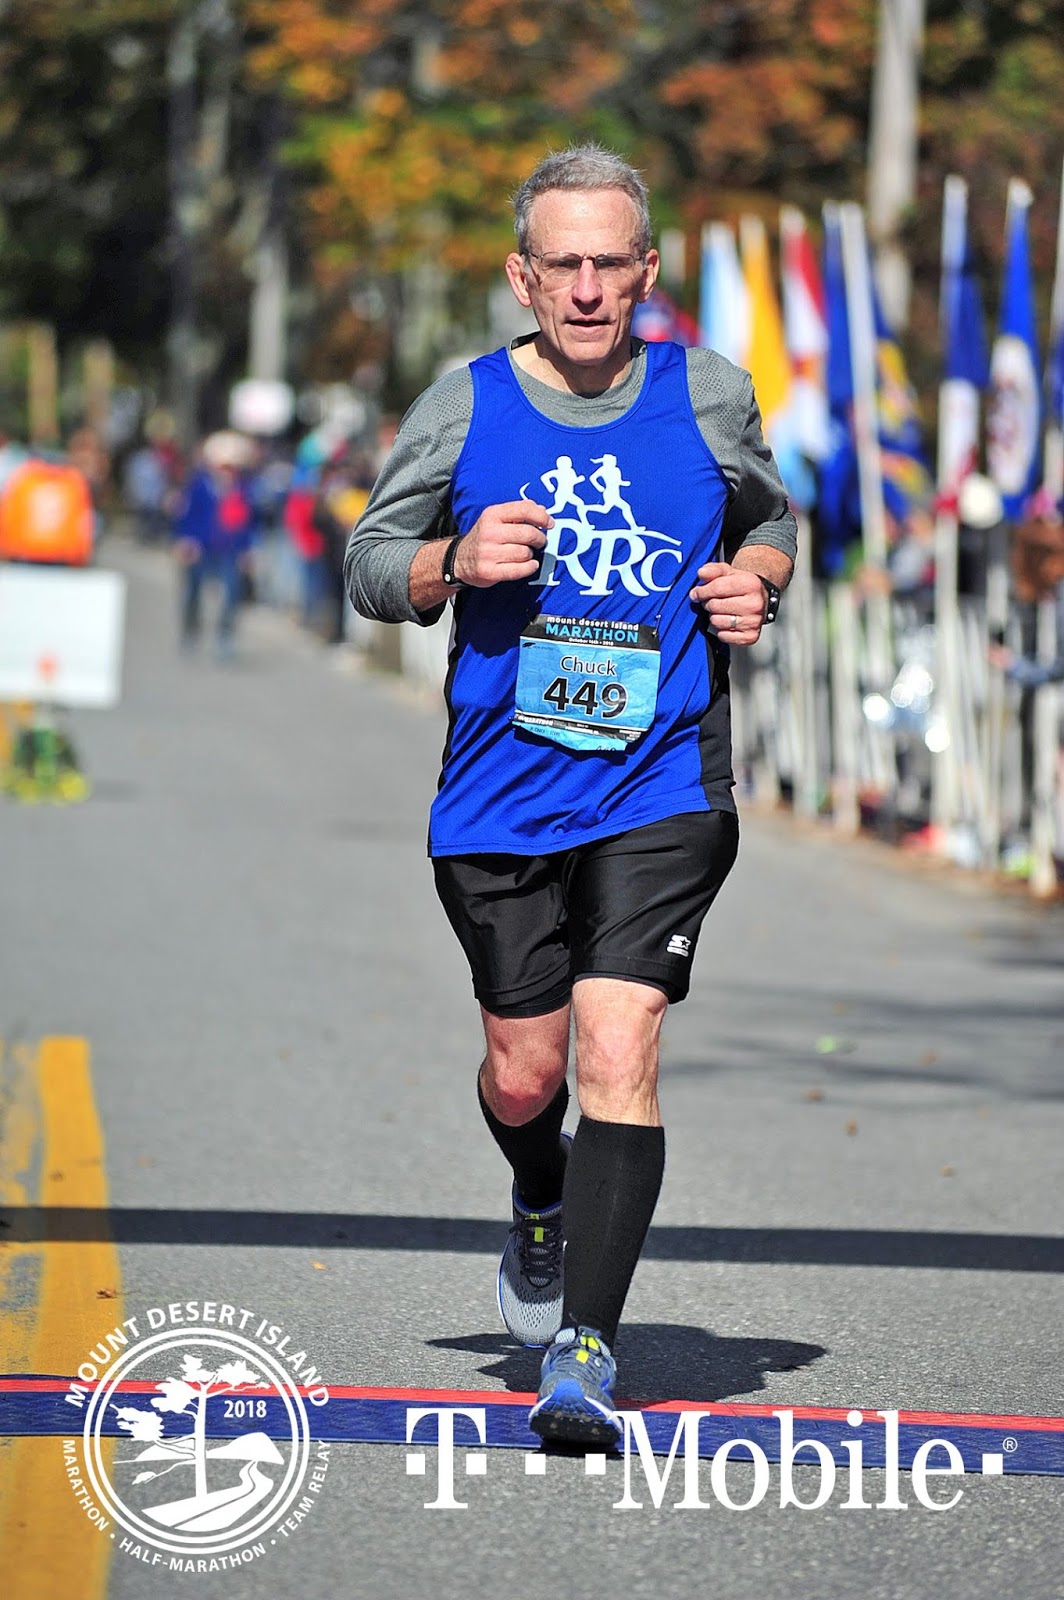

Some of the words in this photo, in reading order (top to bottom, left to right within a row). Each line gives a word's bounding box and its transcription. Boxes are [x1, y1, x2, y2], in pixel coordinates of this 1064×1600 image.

[545, 623, 639, 643] MARATHON
[546, 616, 576, 625] mount
[579, 618, 608, 628] desert
[611, 621, 639, 631] island
[560, 656, 617, 676] Chuck
[543, 677, 627, 718] 449
